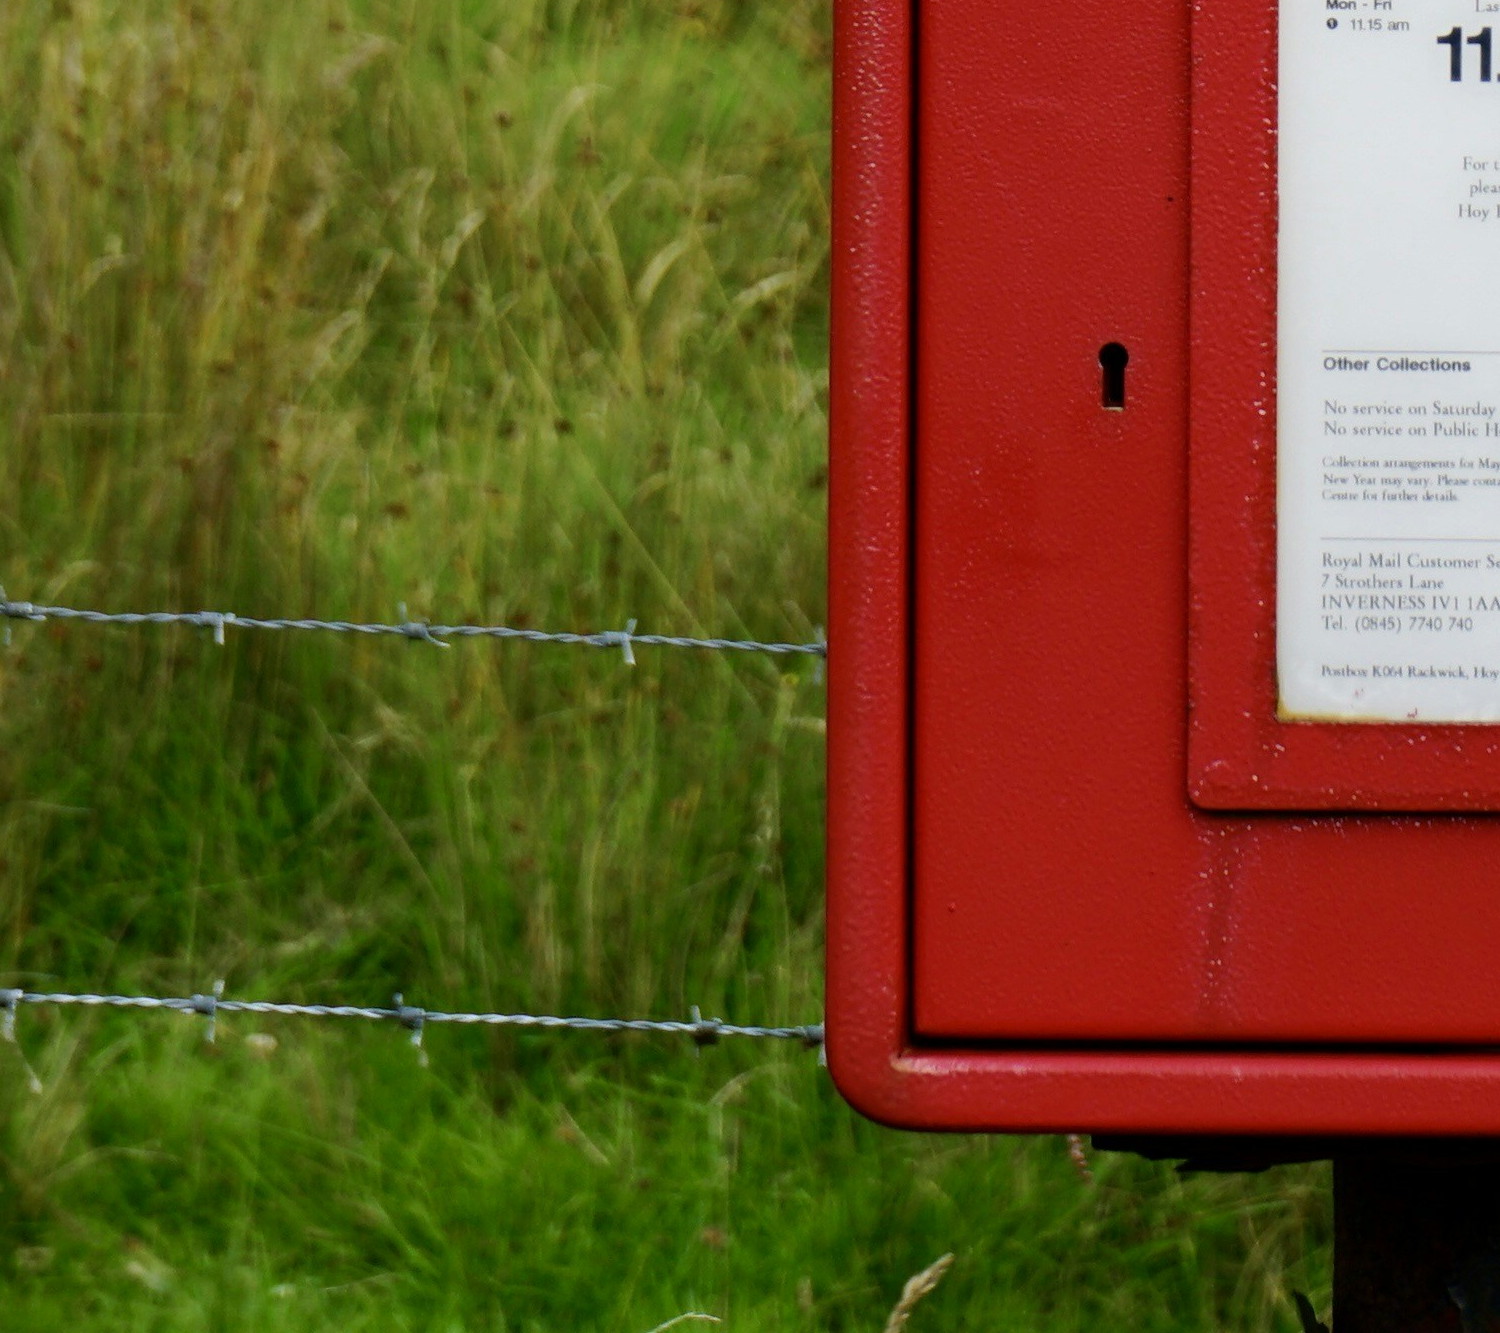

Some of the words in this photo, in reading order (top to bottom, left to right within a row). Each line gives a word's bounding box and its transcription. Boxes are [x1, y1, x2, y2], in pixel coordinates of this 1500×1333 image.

[1350, 18, 1382, 31] 11.15
[1387, 21, 1410, 31] am
[1463, 156, 1488, 171] For
[1458, 203, 1490, 222] Hoy
[1323, 356, 1370, 372] Other
[1376, 357, 1471, 373] Collections
[1324, 399, 1347, 415] No
[1353, 401, 1403, 415] service
[1408, 406, 1427, 416] on
[1433, 400, 1496, 420] Saturday
[1324, 421, 1347, 436] No
[1353, 421, 1403, 437] service
[1408, 427, 1427, 437] on
[1434, 421, 1478, 437] Public
[1323, 552, 1362, 571] Royal
[1369, 552, 1401, 568] Mail
[1407, 553, 1481, 570] Customer
[1322, 573, 1330, 587] 7
[1335, 573, 1403, 589] Strothers
[1410, 574, 1444, 590] Lane
[1321, 594, 1426, 610] INVERNESS
[1432, 595, 1458, 611] IV1
[1321, 615, 1347, 630] Tel.
[1355, 615, 1401, 634] (0845)
[1409, 615, 1443, 632] 7740
[1449, 616, 1475, 632] 740
[1320, 664, 1368, 678] Postbox
[1473, 666, 1500, 682] Hoy
